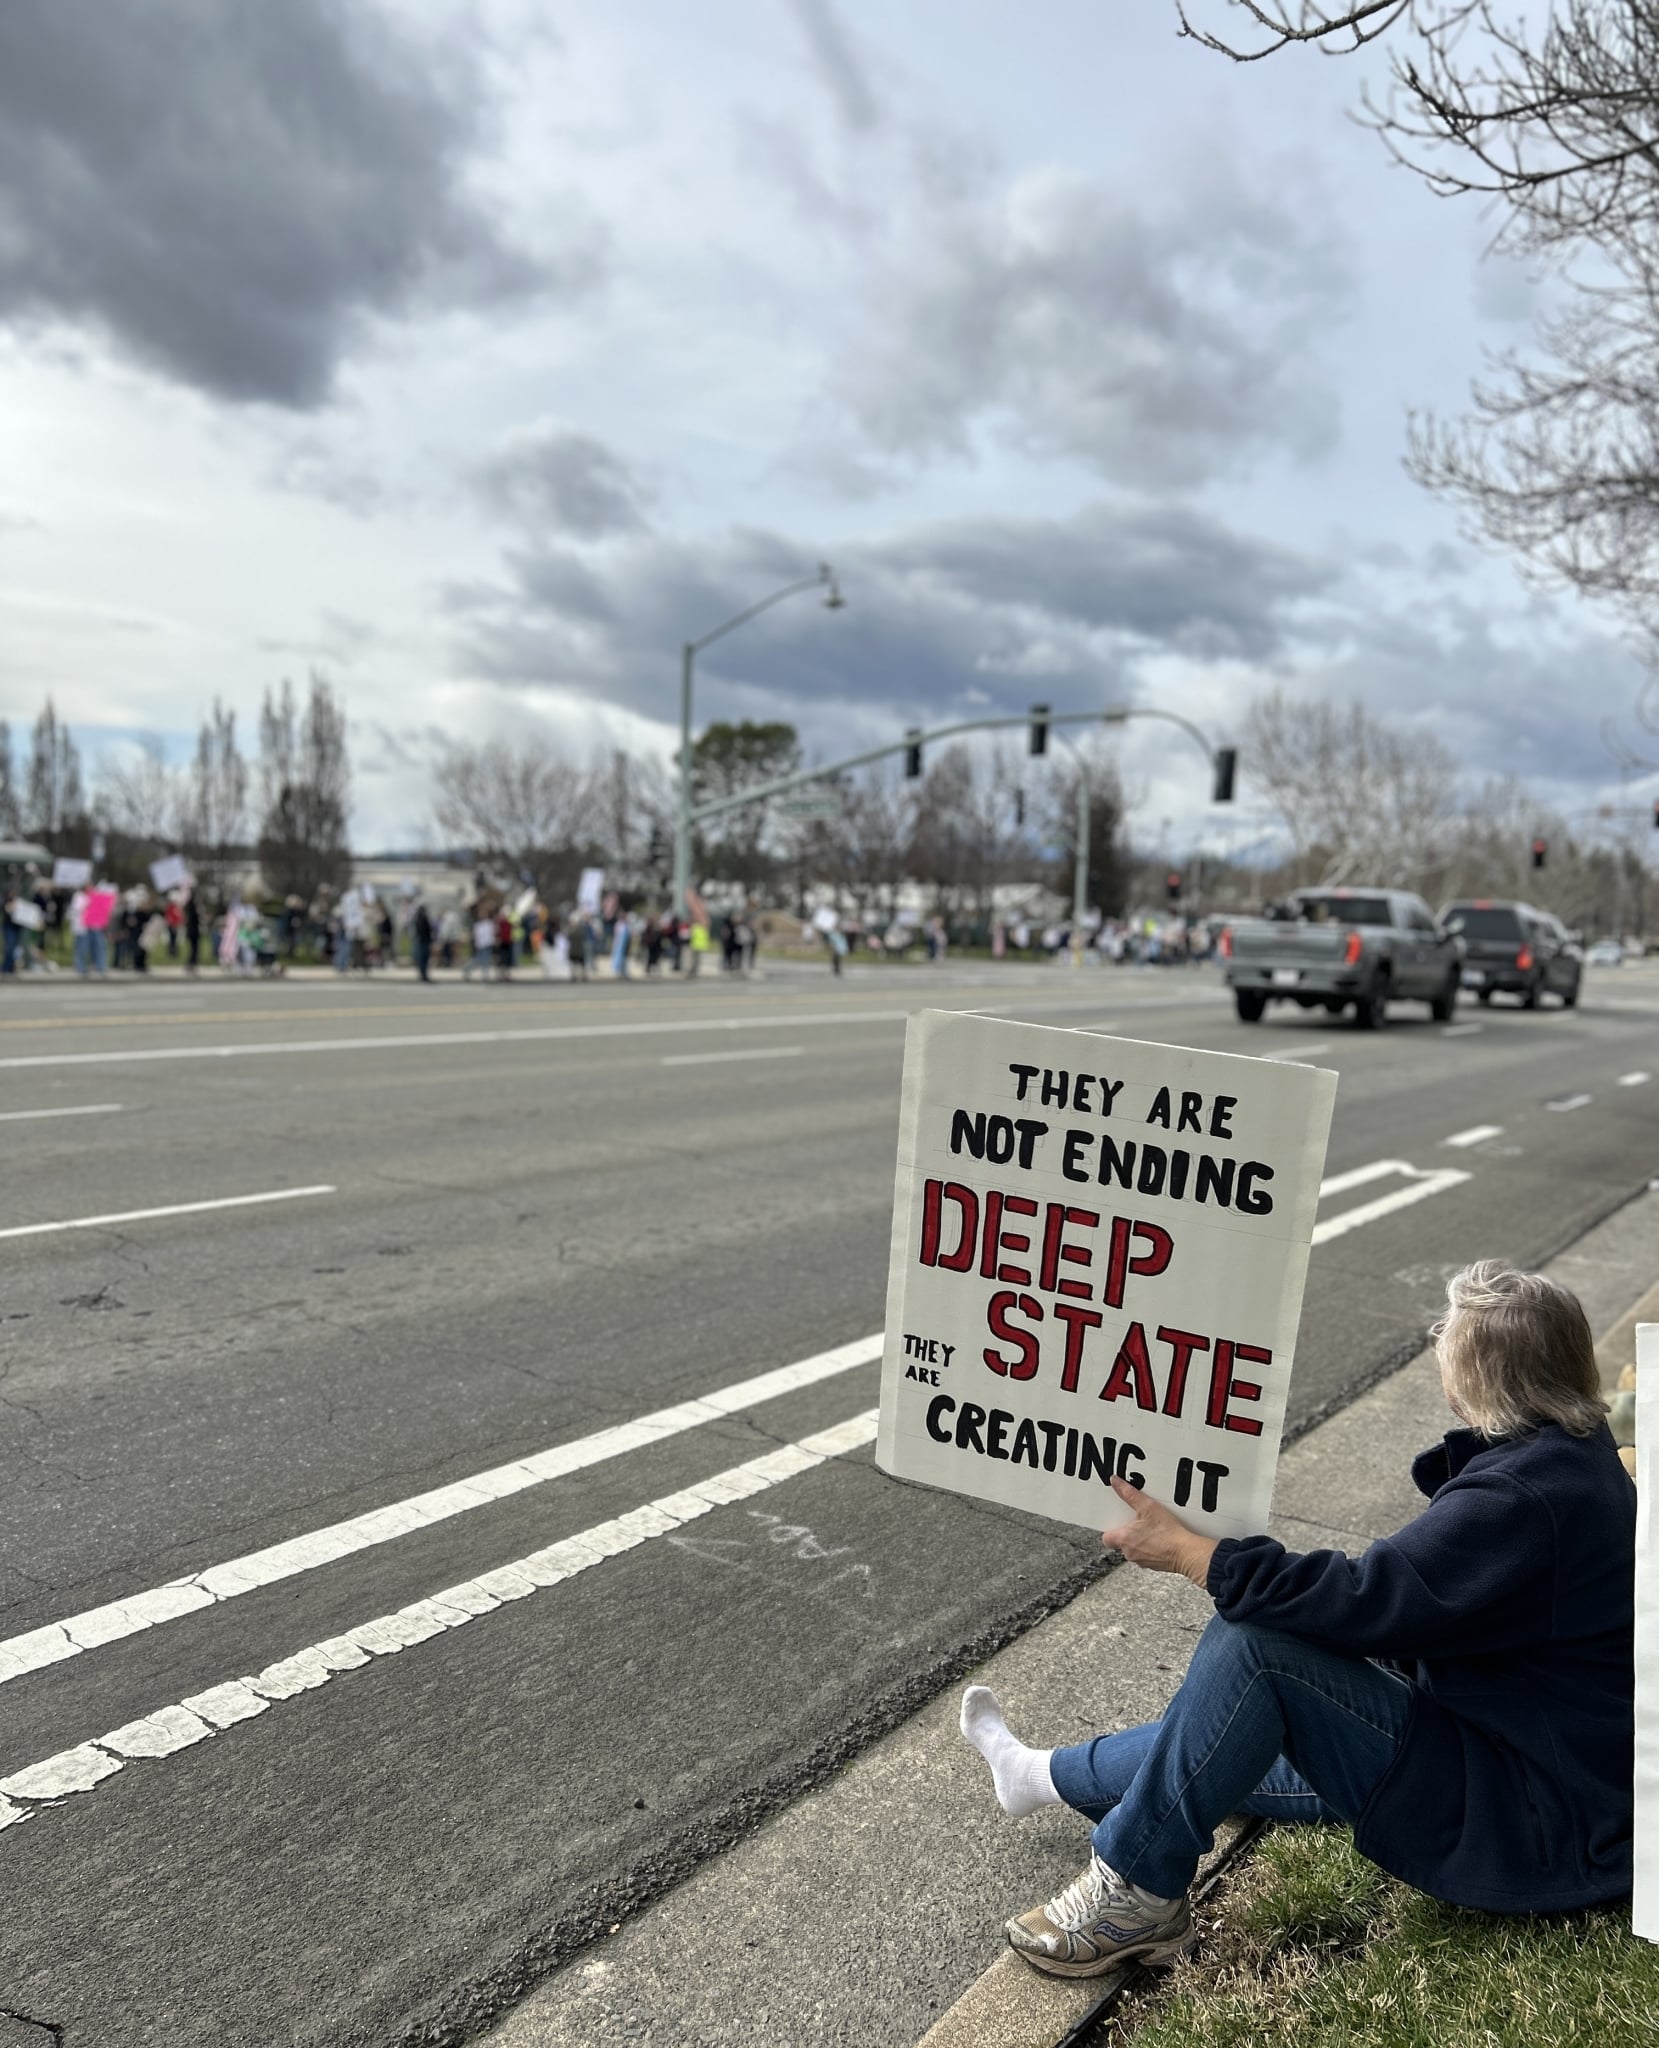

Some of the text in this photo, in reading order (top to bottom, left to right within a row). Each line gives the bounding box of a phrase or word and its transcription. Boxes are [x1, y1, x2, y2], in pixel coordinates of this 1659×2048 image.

[1009, 1063, 1238, 1140] THEY ARE
[950, 1109, 1275, 1215] NOT ENDING
[919, 1178, 1174, 1309] DEEP
[903, 1334, 956, 1367] THEY
[904, 1364, 941, 1387] ARE
[983, 1291, 1273, 1436] STATE
[926, 1394, 1230, 1513] CREATING IT
